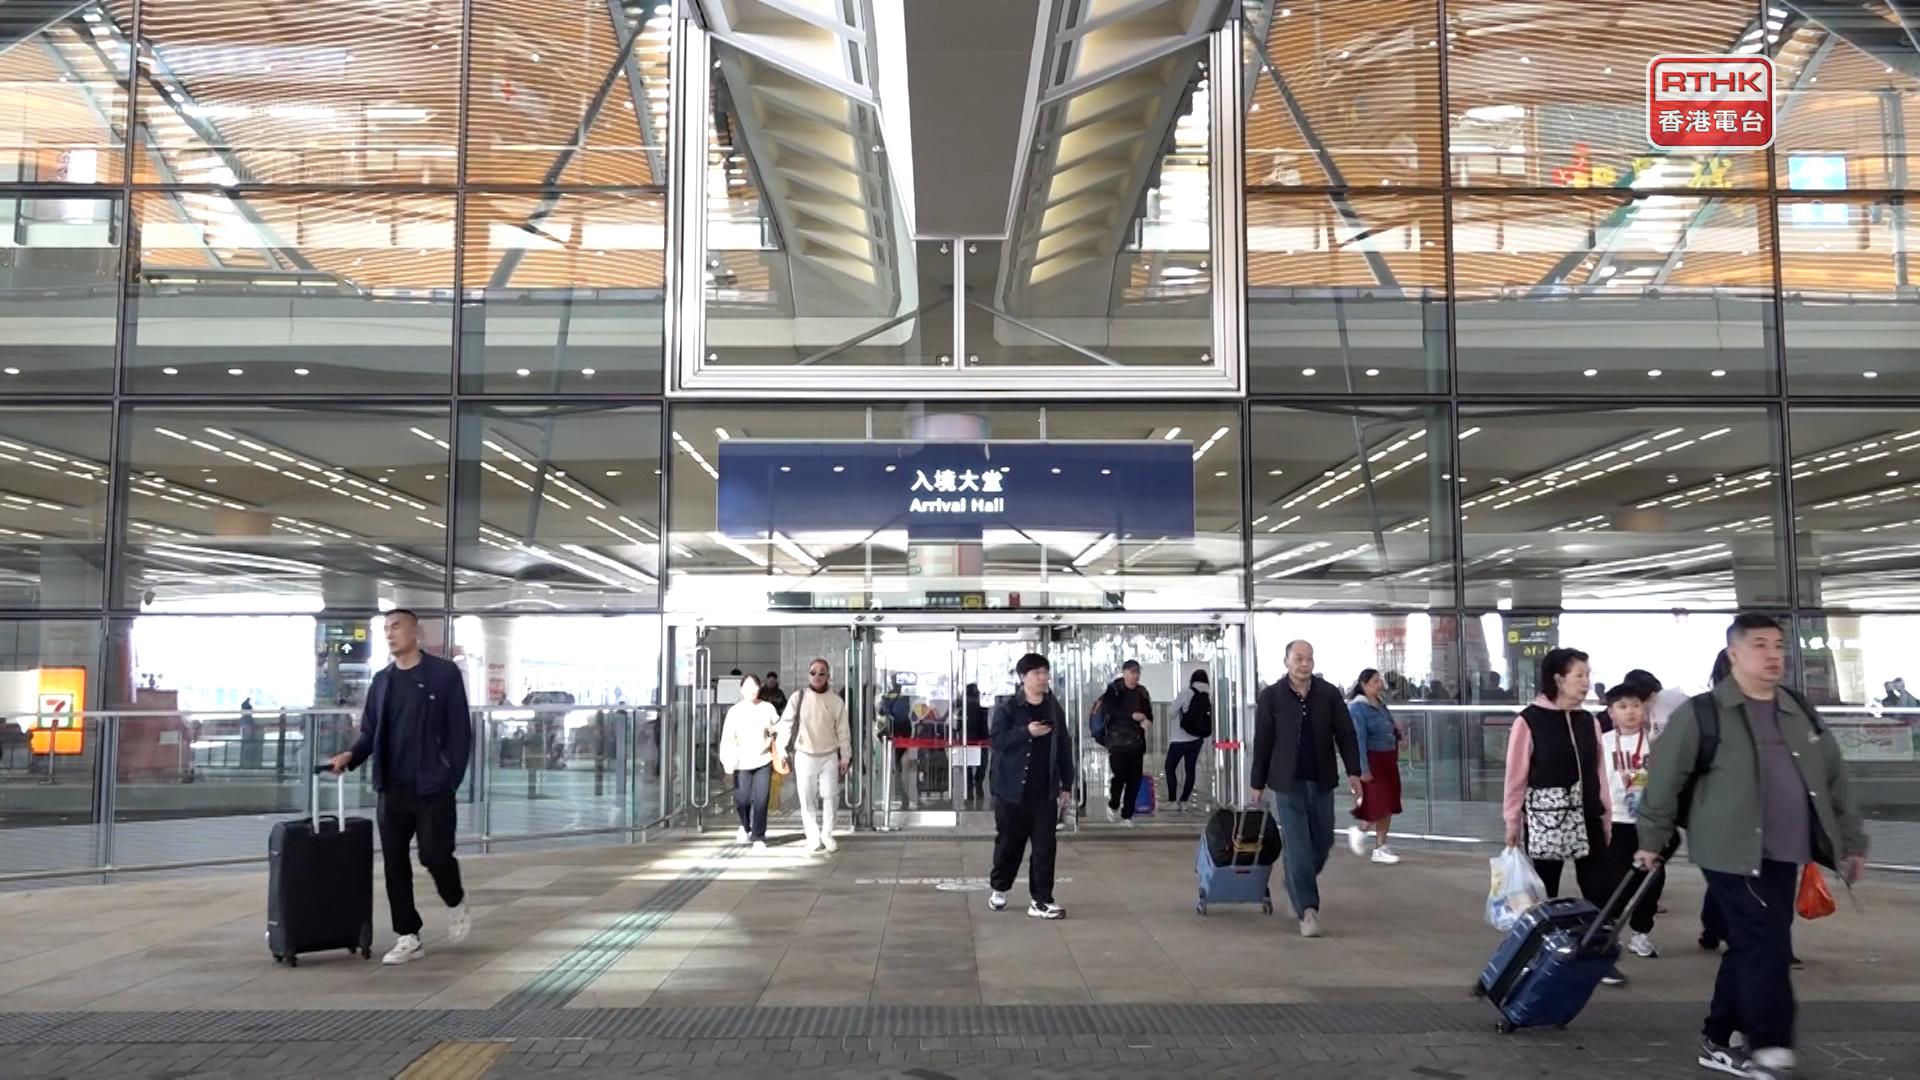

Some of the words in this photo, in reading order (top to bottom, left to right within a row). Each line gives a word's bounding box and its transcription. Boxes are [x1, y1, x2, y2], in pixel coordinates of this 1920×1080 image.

[910, 468, 1004, 493] 入境大堂
[909, 496, 967, 513] Arrival
[970, 496, 1005, 513] Hall
